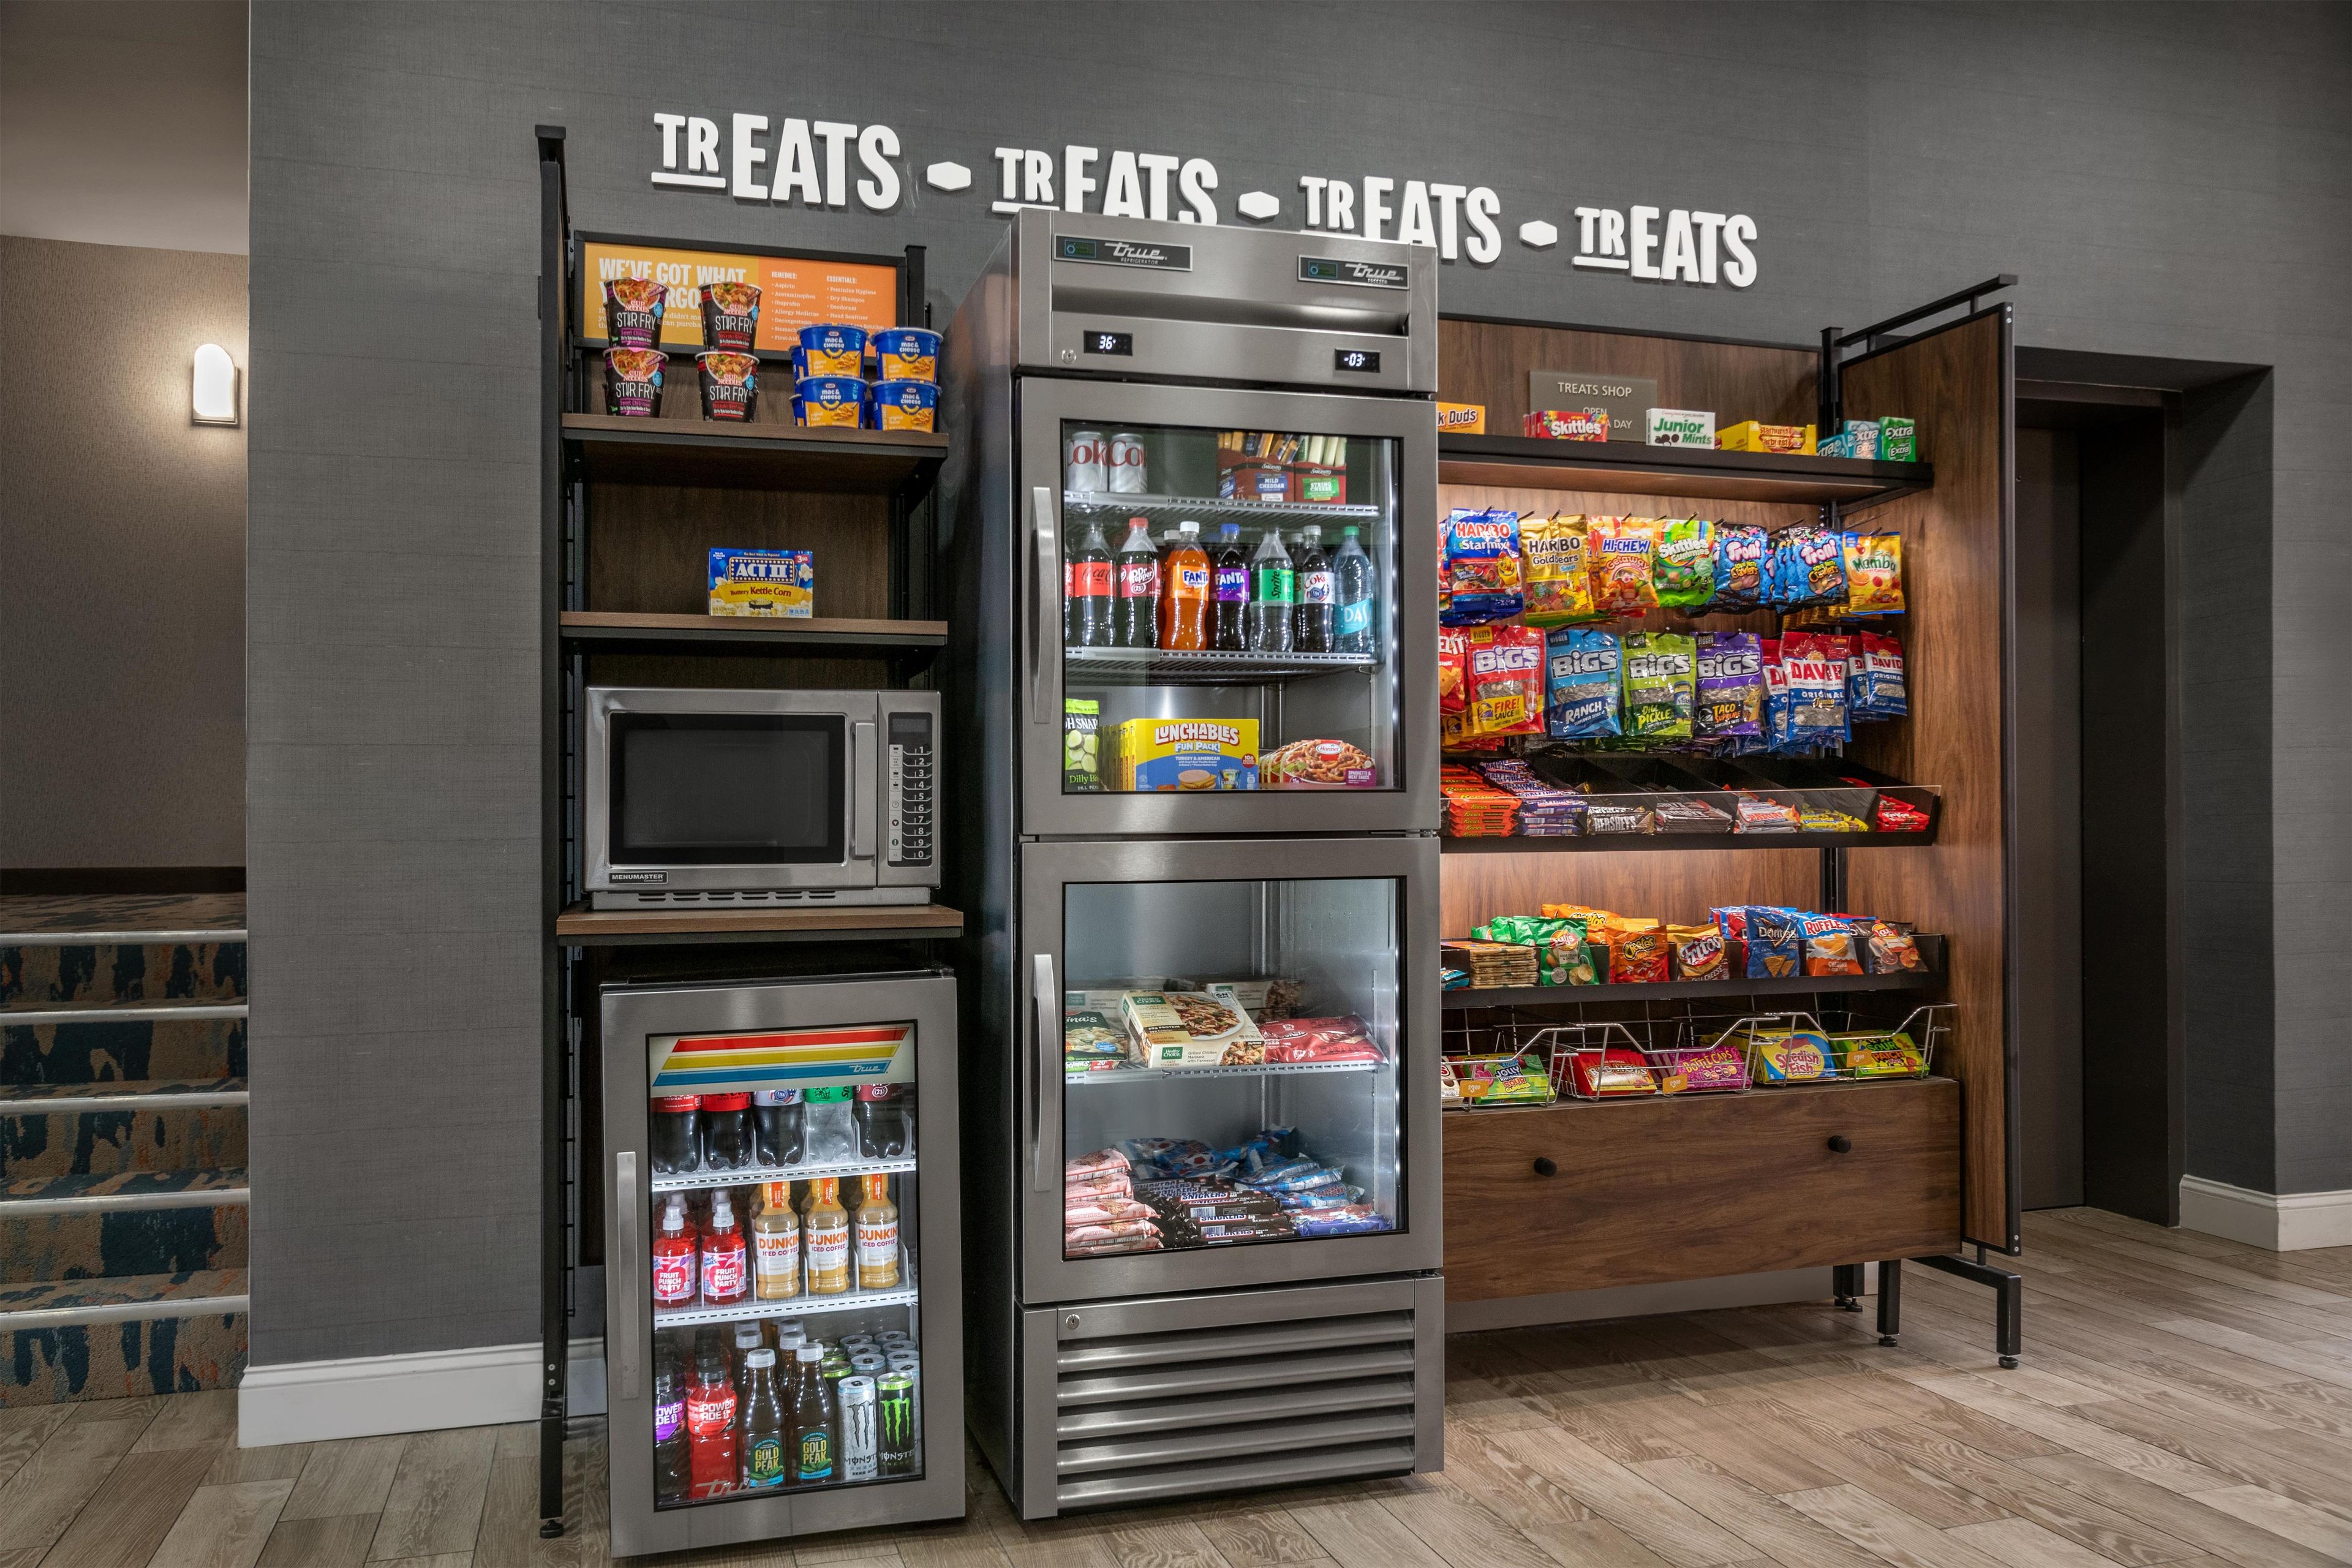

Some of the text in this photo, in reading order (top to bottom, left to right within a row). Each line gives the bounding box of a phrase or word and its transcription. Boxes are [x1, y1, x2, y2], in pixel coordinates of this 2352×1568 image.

[652, 113, 900, 210] TREATS
[993, 145, 1218, 226] TREATS
[1300, 176, 1501, 263] TREATS
[1572, 205, 1757, 288] TREATS
[657, 262, 691, 285] GOT
[696, 265, 746, 286] WHAT
[826, 276, 857, 284] ESSENTIALS:
[775, 292, 816, 300] Acetaminophen
[640, 314, 656, 331] FRY
[739, 317, 753, 333] FRY
[638, 383, 655, 399] FRY
[733, 387, 748, 402] FRY
[1558, 382, 1632, 398] TREATS SHOP
[1449, 409, 1477, 425] Duds
[1582, 407, 1607, 415] OPEN
[1550, 420, 1602, 437] Skittles
[1613, 420, 1632, 429] DAY
[1653, 418, 1705, 434] Junior
[1681, 432, 1713, 445] Mints
[1885, 426, 1913, 438] Extra
[1890, 447, 1909, 456] Extra
[1455, 521, 1511, 539] HARIBO
[1461, 540, 1508, 551] Starmix
[1529, 537, 1581, 554] HARIBO
[1602, 539, 1651, 553] HI-CHEW
[1657, 539, 1709, 557] Skittles
[1726, 540, 1762, 561] Trolli
[1801, 540, 1837, 565] Trolli
[1532, 554, 1578, 565] Goldbears
[1606, 556, 1649, 571] Getaway
[1852, 556, 1897, 573] Mamba
[736, 564, 788, 578] ACT II
[1731, 567, 1758, 579] Crawlers
[1808, 565, 1839, 584] Crawlers
[1215, 572, 1245, 586] FANTA
[1272, 571, 1280, 598] Sprite
[750, 586, 772, 595] Kettle
[774, 588, 791, 597] Corn
[1872, 656, 1902, 669] DAVID
[1874, 673, 1903, 682] ORIGINAL
[1801, 690, 1844, 699] ORIGINAL
[1494, 698, 1520, 712] FIRE!
[1642, 704, 1659, 715] DILL
[1713, 703, 1736, 714] TACO
[1494, 710, 1515, 720] SAUCE
[1566, 701, 1602, 725] RANCH
[1638, 709, 1671, 729] PICKLE
[1714, 711, 1741, 723] SUPREME
[1155, 722, 1240, 746] LUNCHABLES
[1175, 741, 1221, 753] FUN PACK!
[1069, 774, 1088, 784] Dilly
[1594, 815, 1637, 832] HERSHEY'S
[1758, 925, 1798, 941] Doritos
[1804, 919, 1850, 935] RUFFLES
[1623, 936, 1655, 960] Cheetos
[1704, 965, 1723, 981] CHEESE
[1866, 1042, 1897, 1052] SOUR
[1684, 1049, 1733, 1073] BOTTLE CAPS
[1775, 1049, 1820, 1066] Swedish
[1872, 1051, 1905, 1063] PATCH
[1496, 1066, 1521, 1078] JOLLY
[1789, 1061, 1814, 1076] Fish
[1503, 1077, 1526, 1088] SOUR
[1505, 1082, 1531, 1093] GUMMIES
[1182, 1192, 1227, 1200] SNICKERS
[700, 1398, 734, 1412] POWER
[803, 1439, 827, 1453] GOLD
[755, 1447, 779, 1461] GOLD
[803, 1450, 827, 1464] PEAK
[755, 1458, 779, 1472] PEAK
